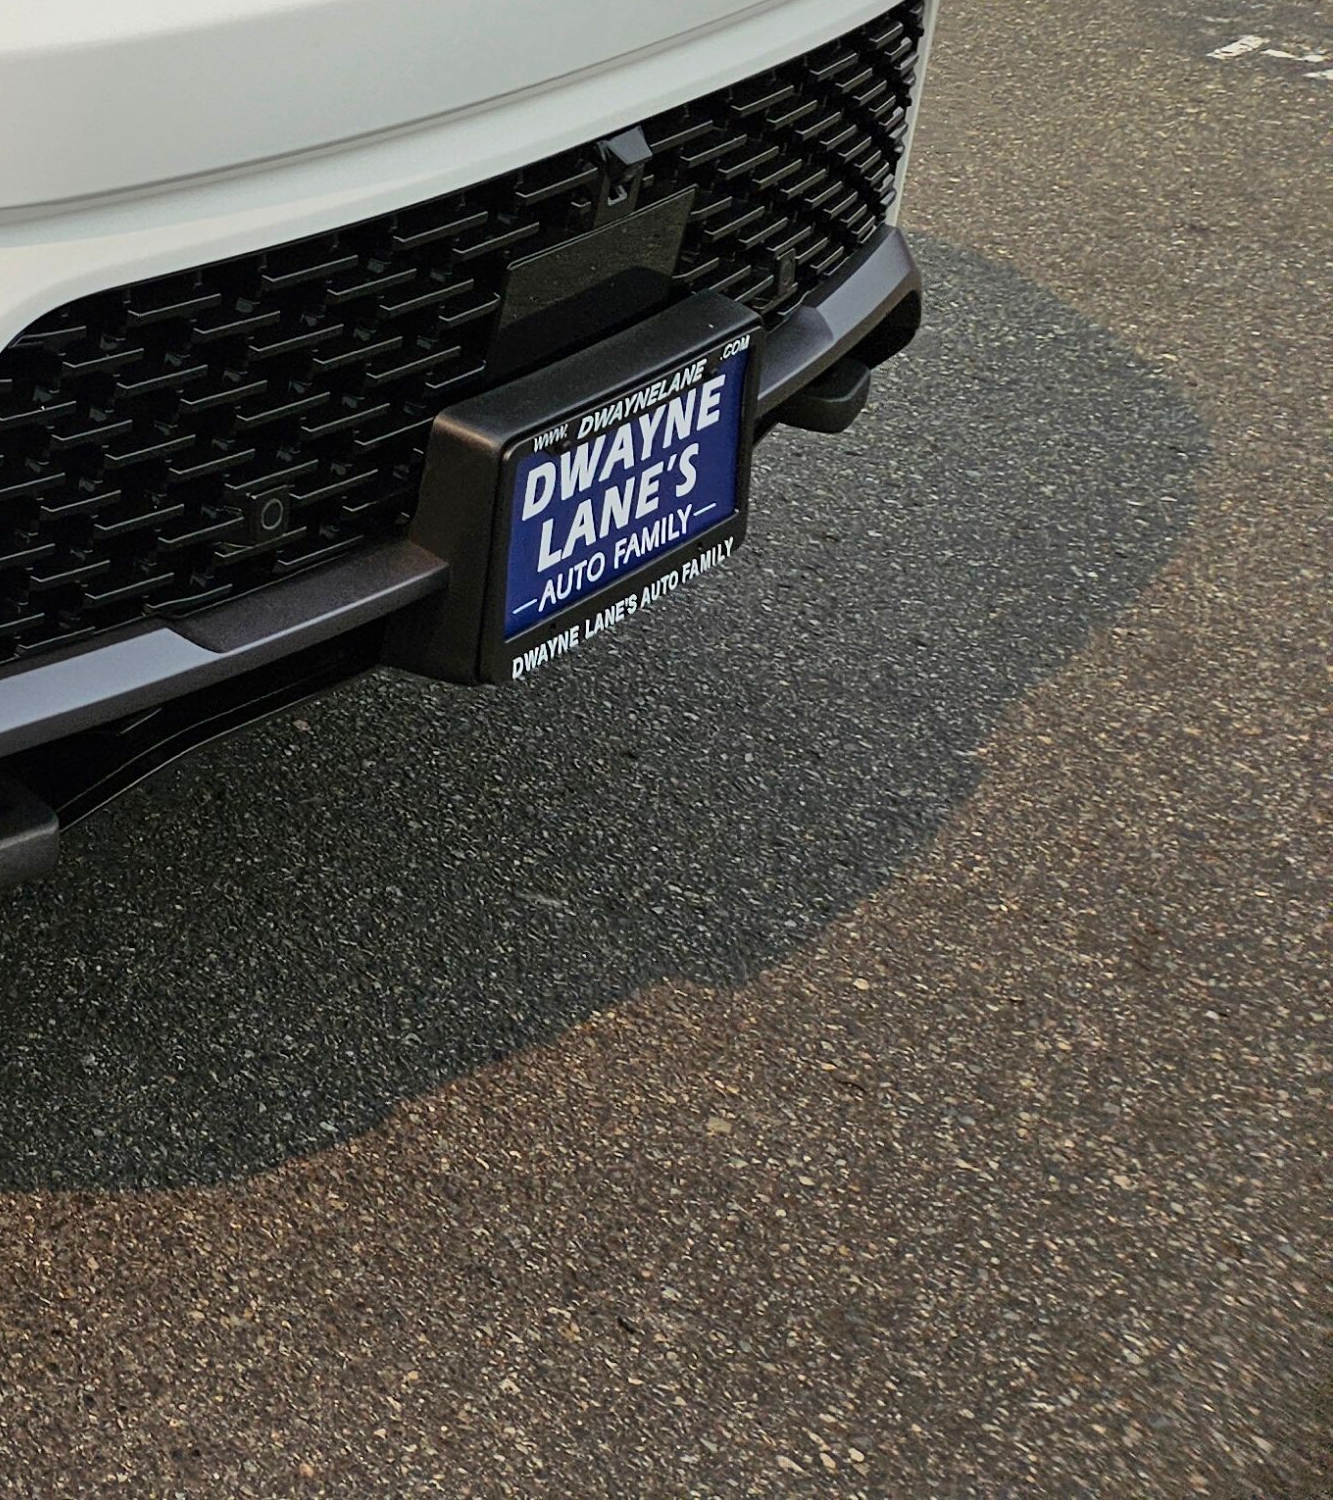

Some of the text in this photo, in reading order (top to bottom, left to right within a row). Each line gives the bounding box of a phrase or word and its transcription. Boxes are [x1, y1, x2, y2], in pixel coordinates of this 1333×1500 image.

[522, 373, 726, 522] DWAYNE
[577, 358, 708, 440] DWAYNELANE
[537, 448, 700, 573] LANE'S
[538, 503, 694, 613] AUTO FAMILY
[512, 535, 735, 680] DWAYNE LANE'S AUTO FAMILY
